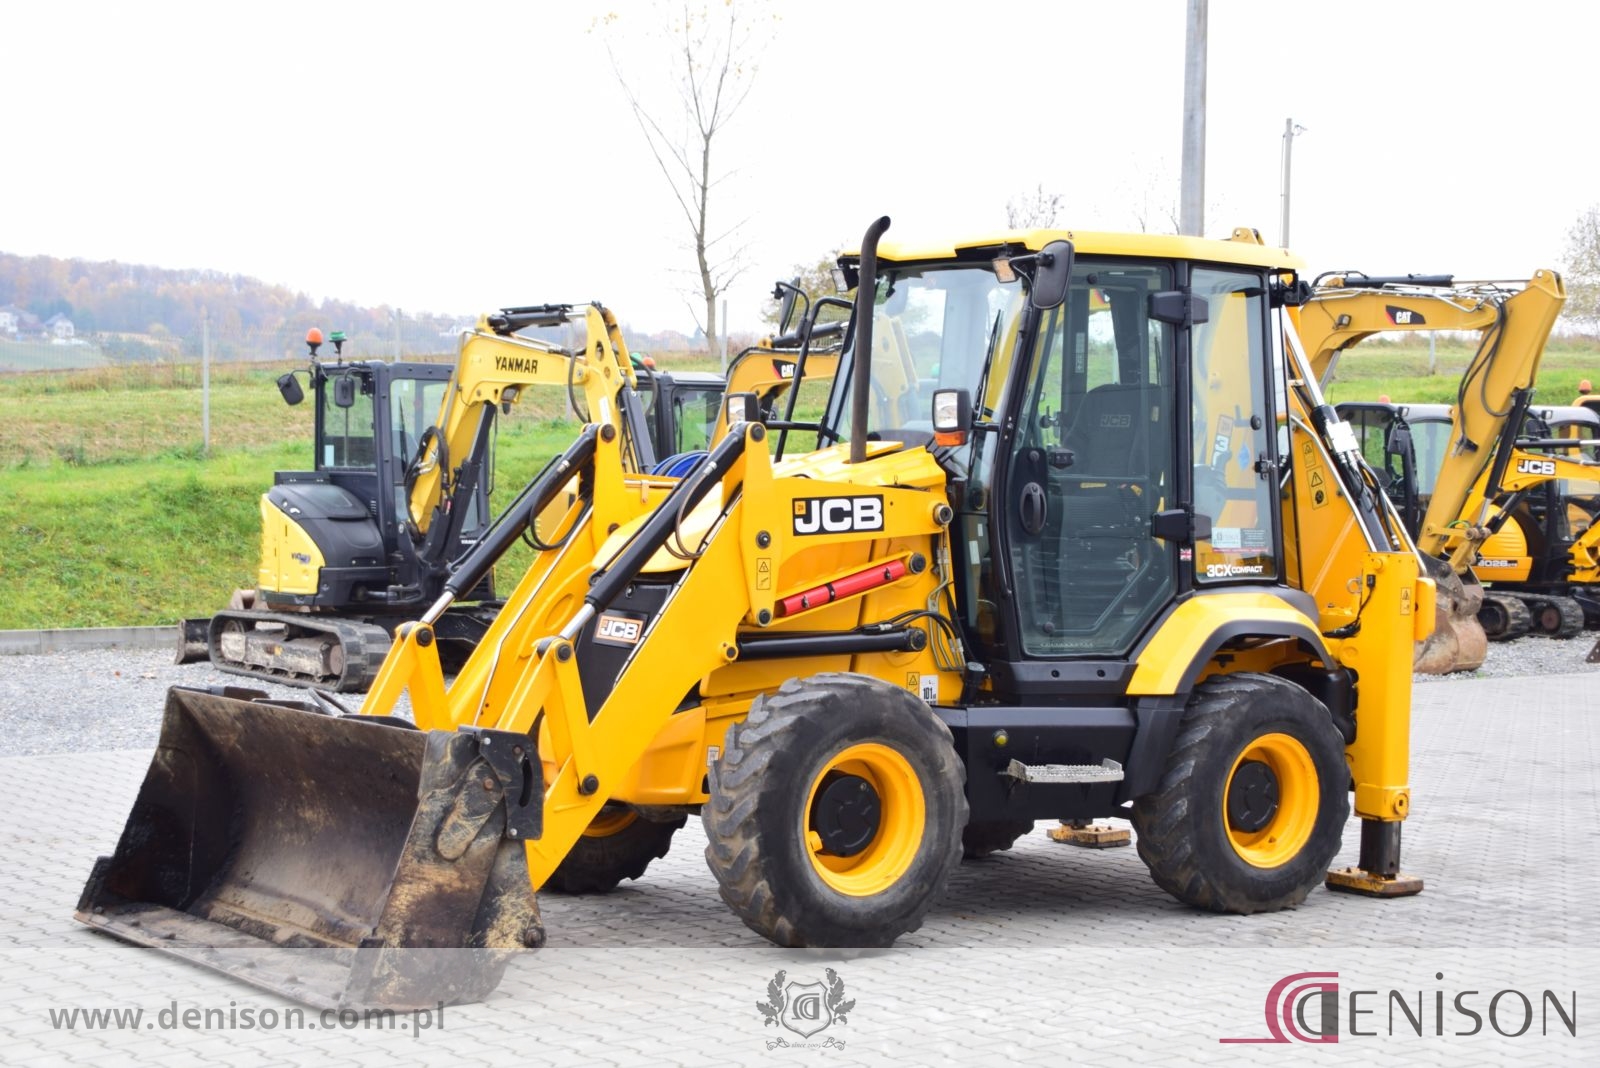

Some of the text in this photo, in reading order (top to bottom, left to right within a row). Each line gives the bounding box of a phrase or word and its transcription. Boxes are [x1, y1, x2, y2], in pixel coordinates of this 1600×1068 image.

[1396, 311, 1411, 324] CAT
[495, 355, 539, 375] YANMAR
[781, 364, 795, 378] CAT
[1517, 459, 1556, 475] JCB
[794, 497, 883, 534] JCB
[1206, 563, 1263, 577] 3CX COMPACT
[600, 619, 640, 641] JCB
